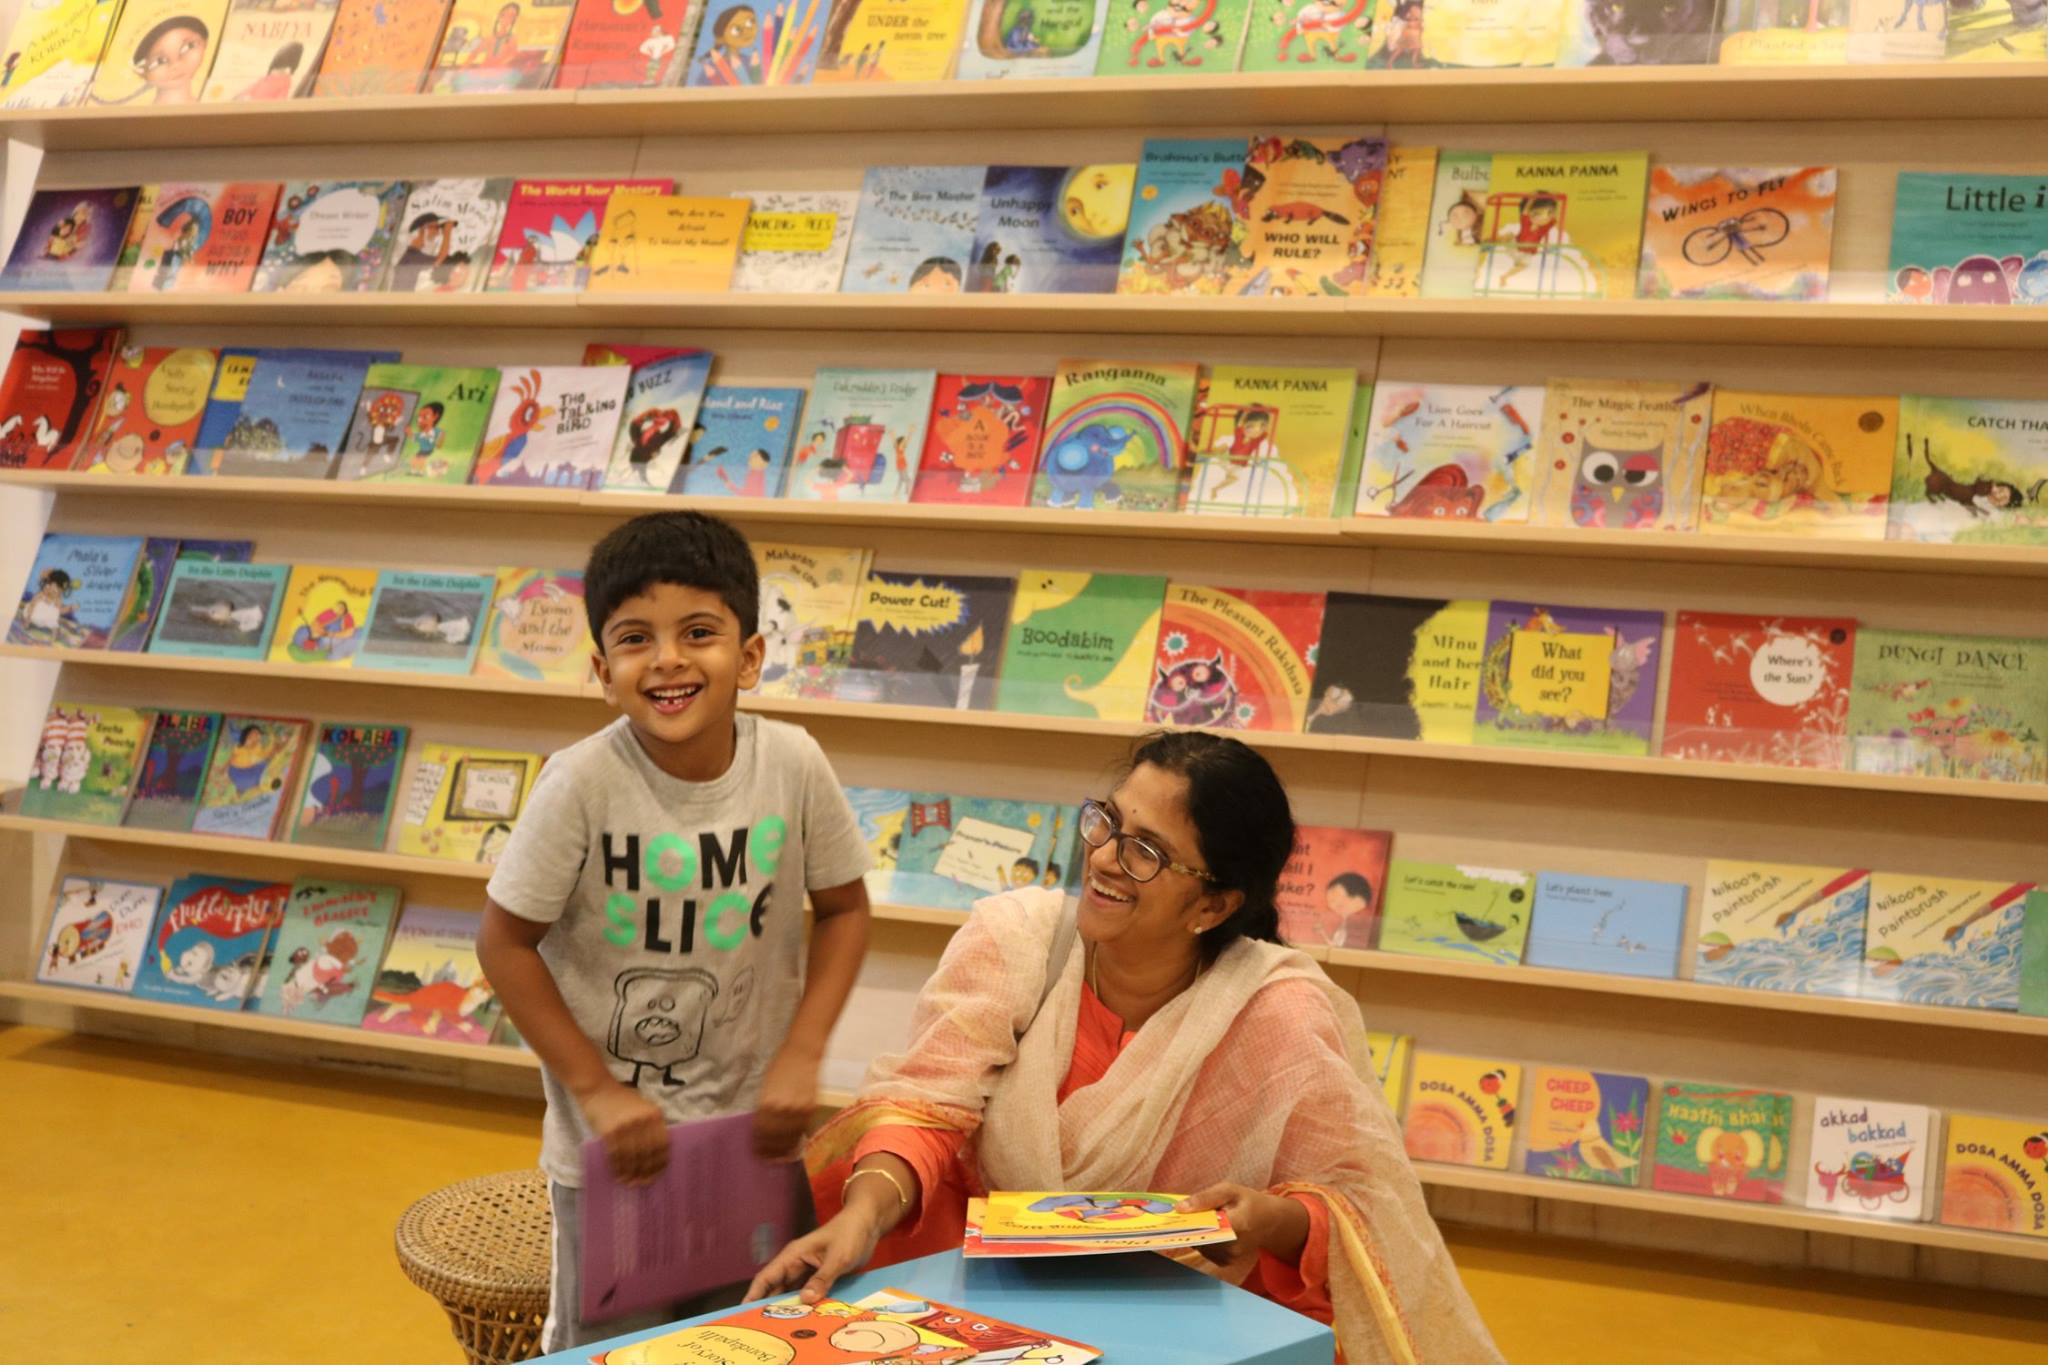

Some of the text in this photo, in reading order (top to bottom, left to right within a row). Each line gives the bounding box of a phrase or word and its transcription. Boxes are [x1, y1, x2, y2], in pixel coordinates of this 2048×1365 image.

[866, 15, 931, 28] UNDER the
[1516, 164, 1619, 178] KANNA PANNA
[520, 184, 543, 196] The
[545, 184, 581, 196] World
[584, 184, 611, 196] Tour
[1662, 175, 1787, 222] WINGS TO FLY
[991, 198, 1051, 213] Unhappy
[1946, 186, 2026, 212] Little
[222, 208, 257, 225] BOY
[998, 216, 1040, 228] Moon
[1264, 232, 1341, 245] WHO WILL
[1273, 247, 1321, 259] RULE?
[1065, 367, 1167, 388] Ranganna
[1234, 377, 1328, 392] KANNA PANNA
[448, 384, 488, 404] Ari
[559, 394, 586, 406] THE
[558, 401, 617, 421] TALKING
[1428, 404, 1484, 416] Lion Goes
[1572, 396, 1594, 408] The
[1598, 397, 1636, 411] Magic
[556, 419, 591, 435] BIRD
[974, 419, 986, 432] A
[1415, 417, 1492, 431] For A Haircut
[1967, 415, 2016, 430] CATCH
[765, 550, 818, 569] Maharani
[422, 577, 443, 589] Little
[445, 579, 481, 592] Dolphin
[869, 591, 951, 609] Power Cut!
[1021, 627, 1115, 652] Boodabim
[1179, 589, 1304, 697] The Pleasant Rakshasa
[1431, 634, 1479, 651] Minu
[1541, 642, 1583, 660] What
[1421, 656, 1483, 671] and her
[1767, 653, 1814, 668] Where's
[1956, 648, 2029, 672] DANCE
[1531, 664, 1586, 684] did you
[1764, 670, 1814, 685] the Sun?
[1428, 675, 1473, 691] Hair
[1539, 686, 1573, 704] see?
[1712, 870, 1762, 898] Nikoo's
[1712, 873, 1782, 923] Paintbrush
[1876, 883, 1928, 913] Nikoo's
[1878, 887, 1949, 938] Paintbrush
[1546, 1078, 1592, 1093] CHEEP
[1550, 1097, 1595, 1112] CHEEP
[1420, 1080, 1497, 1163] DOSA AMMA DOSA
[1667, 1103, 1767, 1127] Haathi Bhai
[1819, 1106, 1869, 1128] akkad
[1846, 1120, 1908, 1142] bakkad
[1955, 1142, 2047, 1232] DOSA AMMA DOSA
[696, 1330, 778, 1362] Bondapalli
